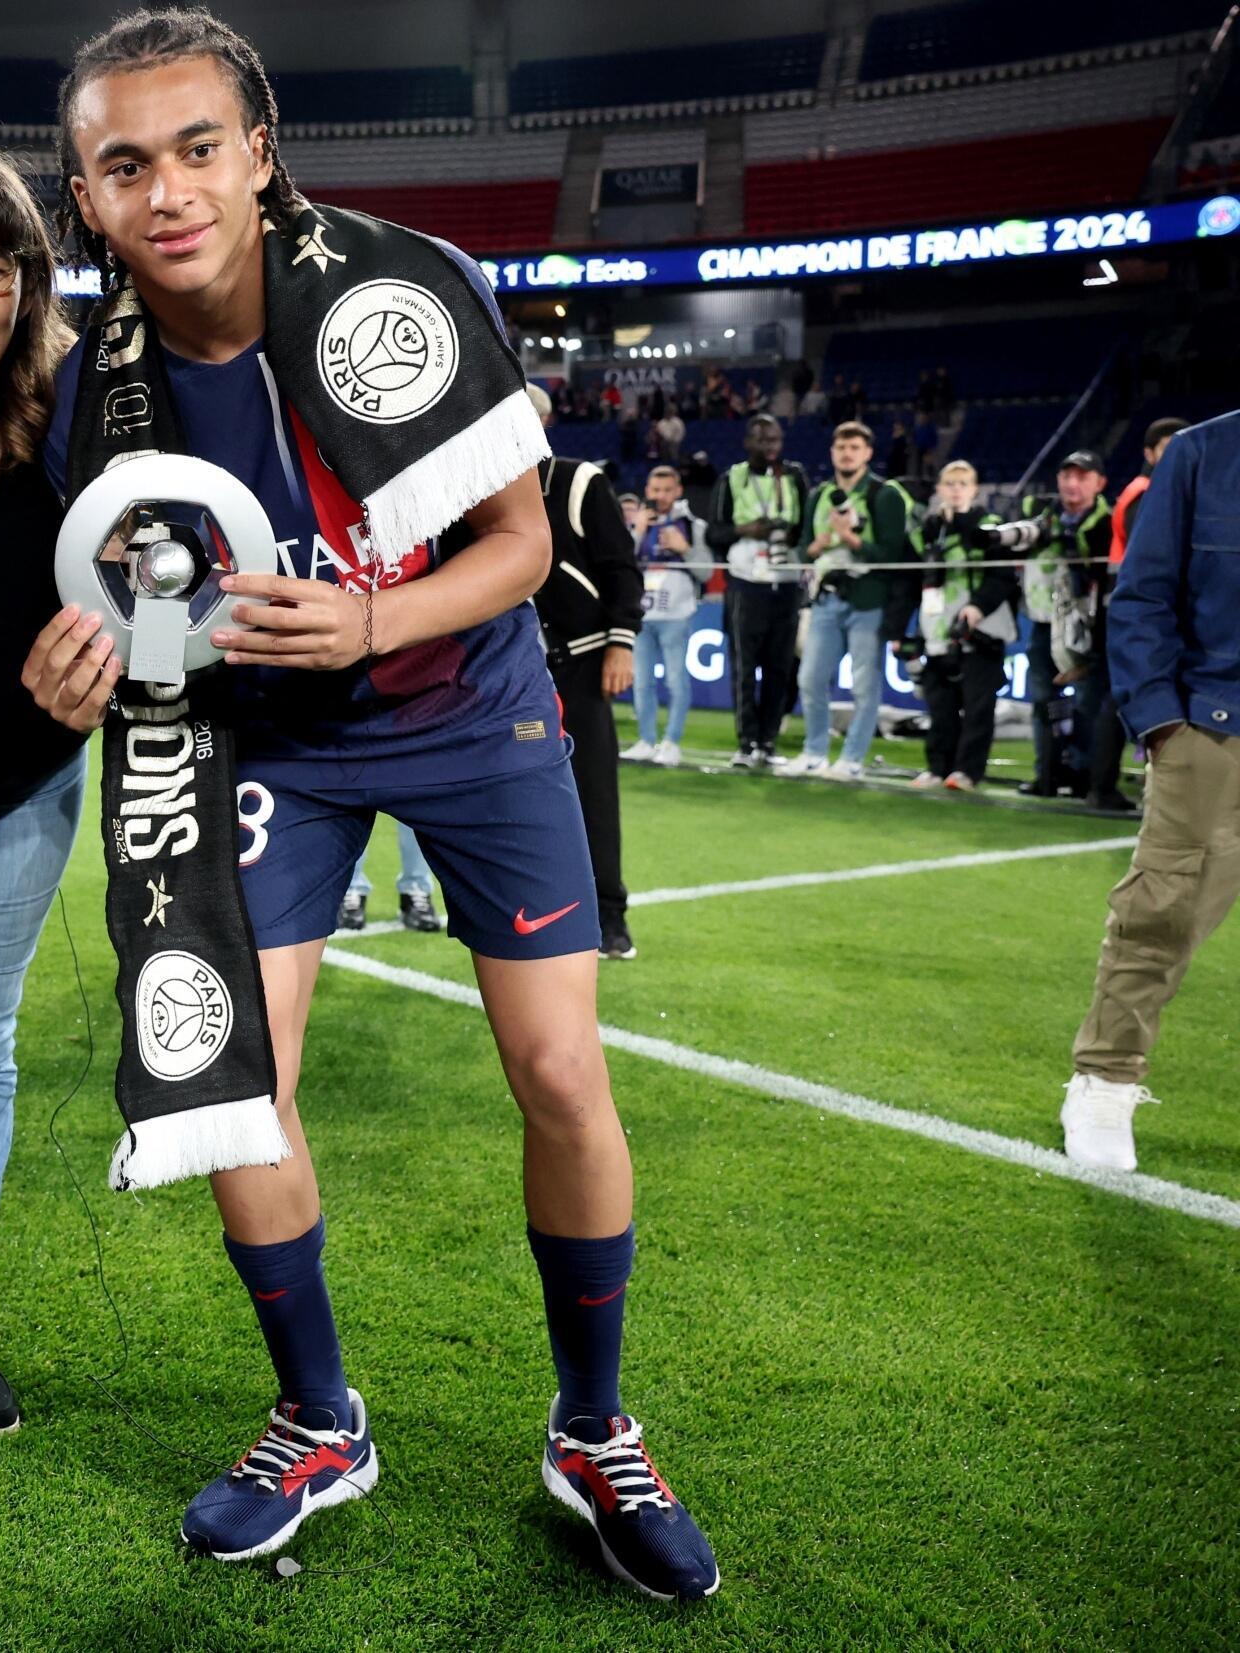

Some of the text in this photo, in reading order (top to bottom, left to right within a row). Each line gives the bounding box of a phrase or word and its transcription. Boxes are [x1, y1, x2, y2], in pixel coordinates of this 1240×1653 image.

[586, 259, 647, 282] Eats
[698, 211, 1151, 281] CHAMPION DE FRANCE 2024
[328, 336, 382, 413] PARIS
[194, 720, 214, 761] 2016
[112, 818, 130, 865] 2024
[192, 968, 223, 1048] PARIS
